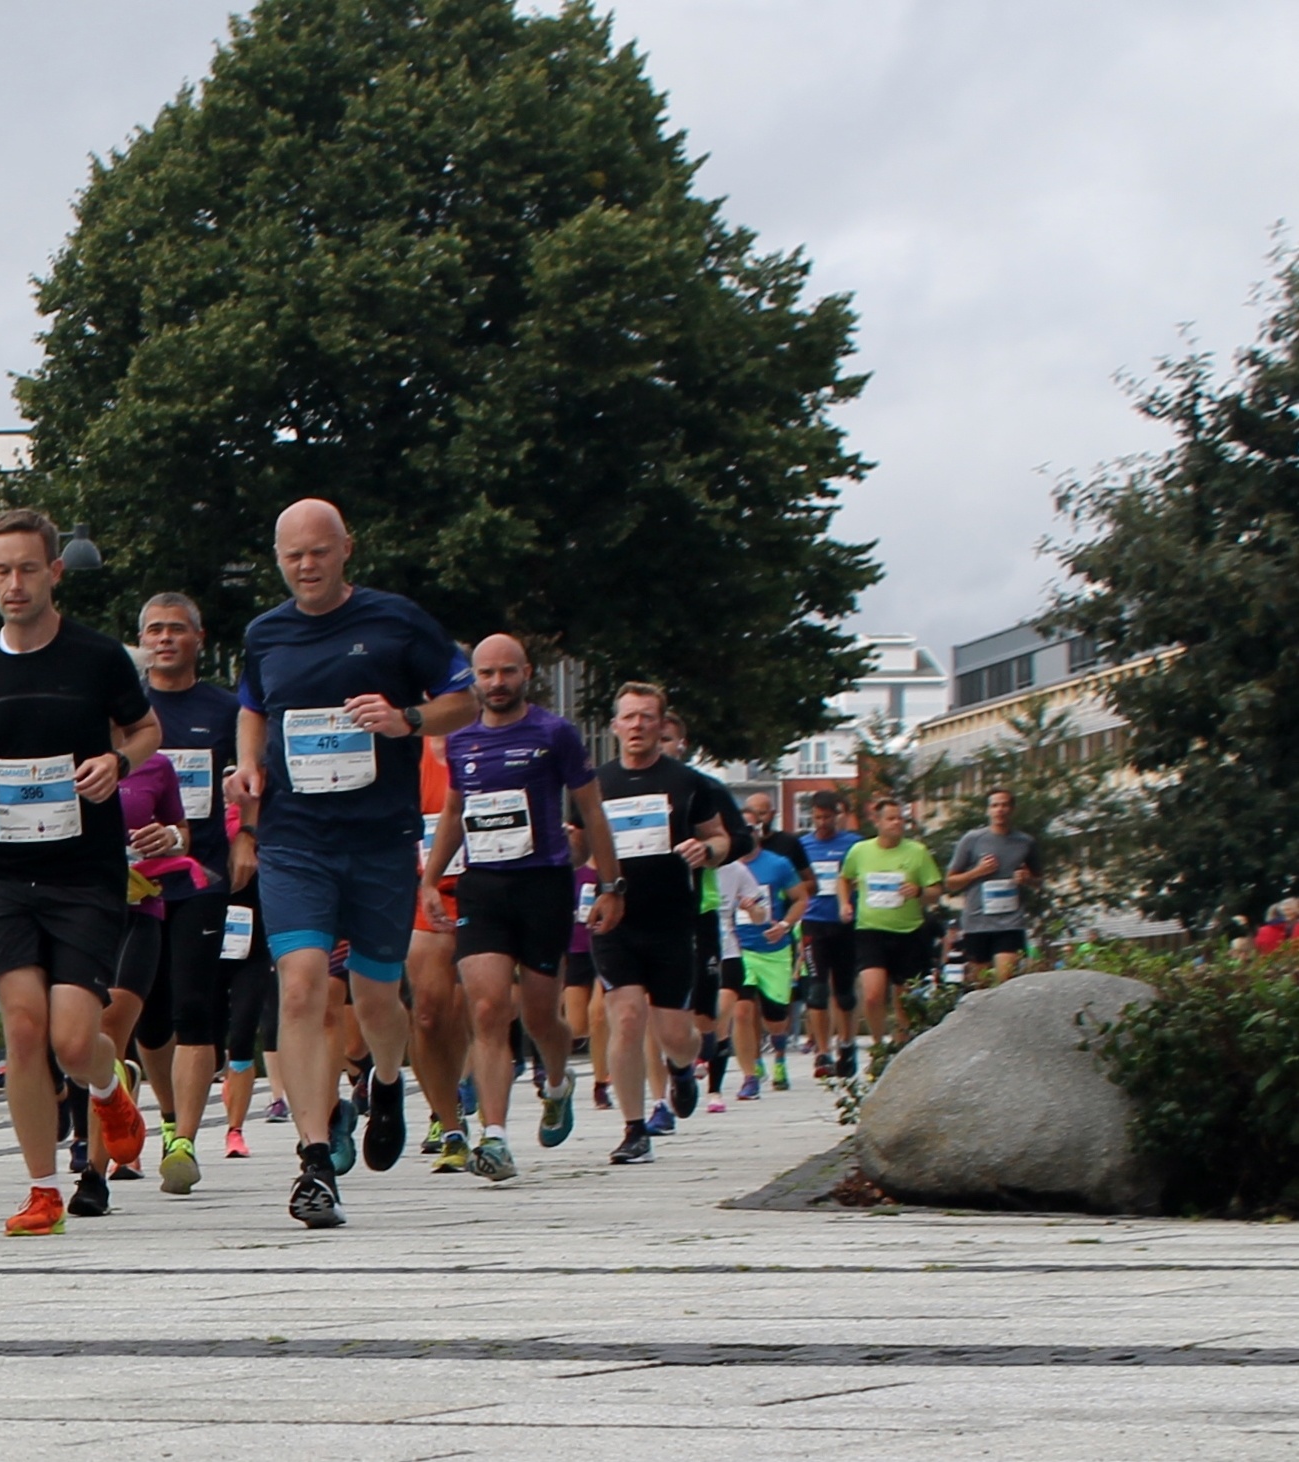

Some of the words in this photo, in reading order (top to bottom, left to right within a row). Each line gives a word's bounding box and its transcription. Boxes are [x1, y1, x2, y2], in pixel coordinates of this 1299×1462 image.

[316, 735, 340, 750] 476
[20, 785, 45, 800] 396
[474, 815, 515, 828] Thomas
